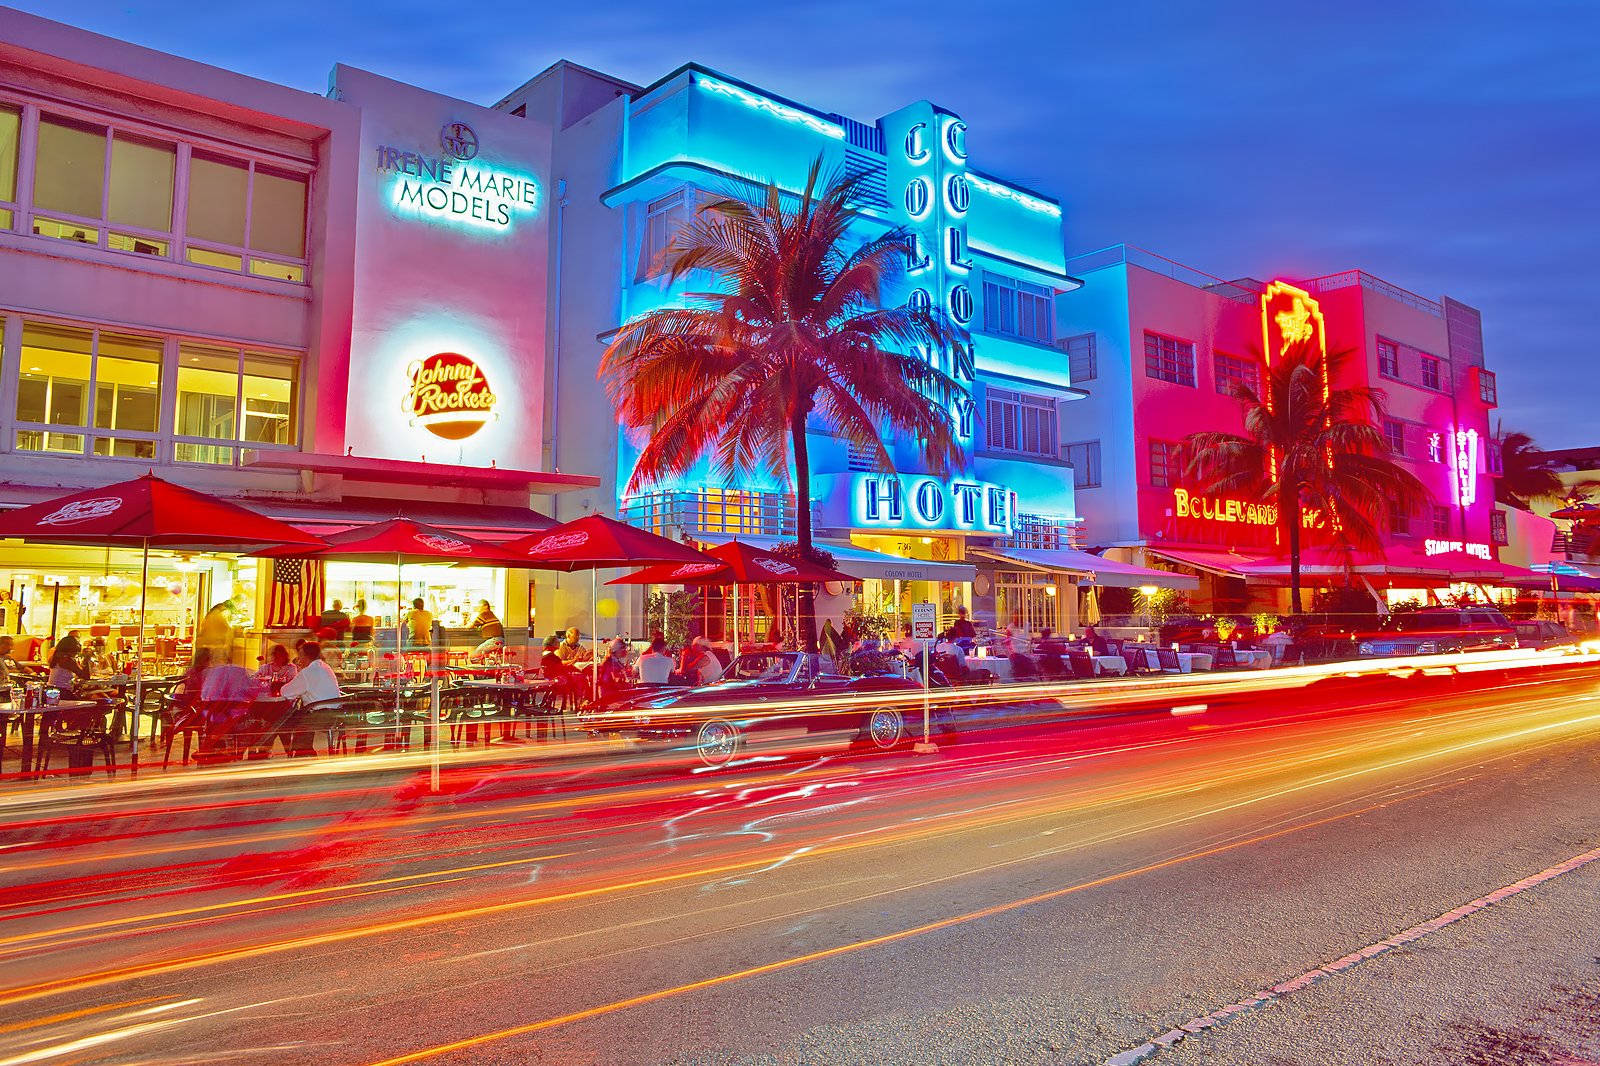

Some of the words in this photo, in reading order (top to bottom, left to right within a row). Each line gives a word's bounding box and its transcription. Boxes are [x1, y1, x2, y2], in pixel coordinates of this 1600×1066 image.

[376, 145, 452, 184] IRENE
[460, 168, 535, 204] MARIE
[401, 180, 510, 225] MODELS
[946, 121, 976, 437] COLONY
[401, 359, 484, 413] Johnny
[414, 384, 497, 415] Rockets
[1456, 431, 1471, 507] STARLITE
[866, 478, 1021, 530] HOTEL
[897, 542, 912, 551] 736
[884, 570, 905, 578] COLONY
